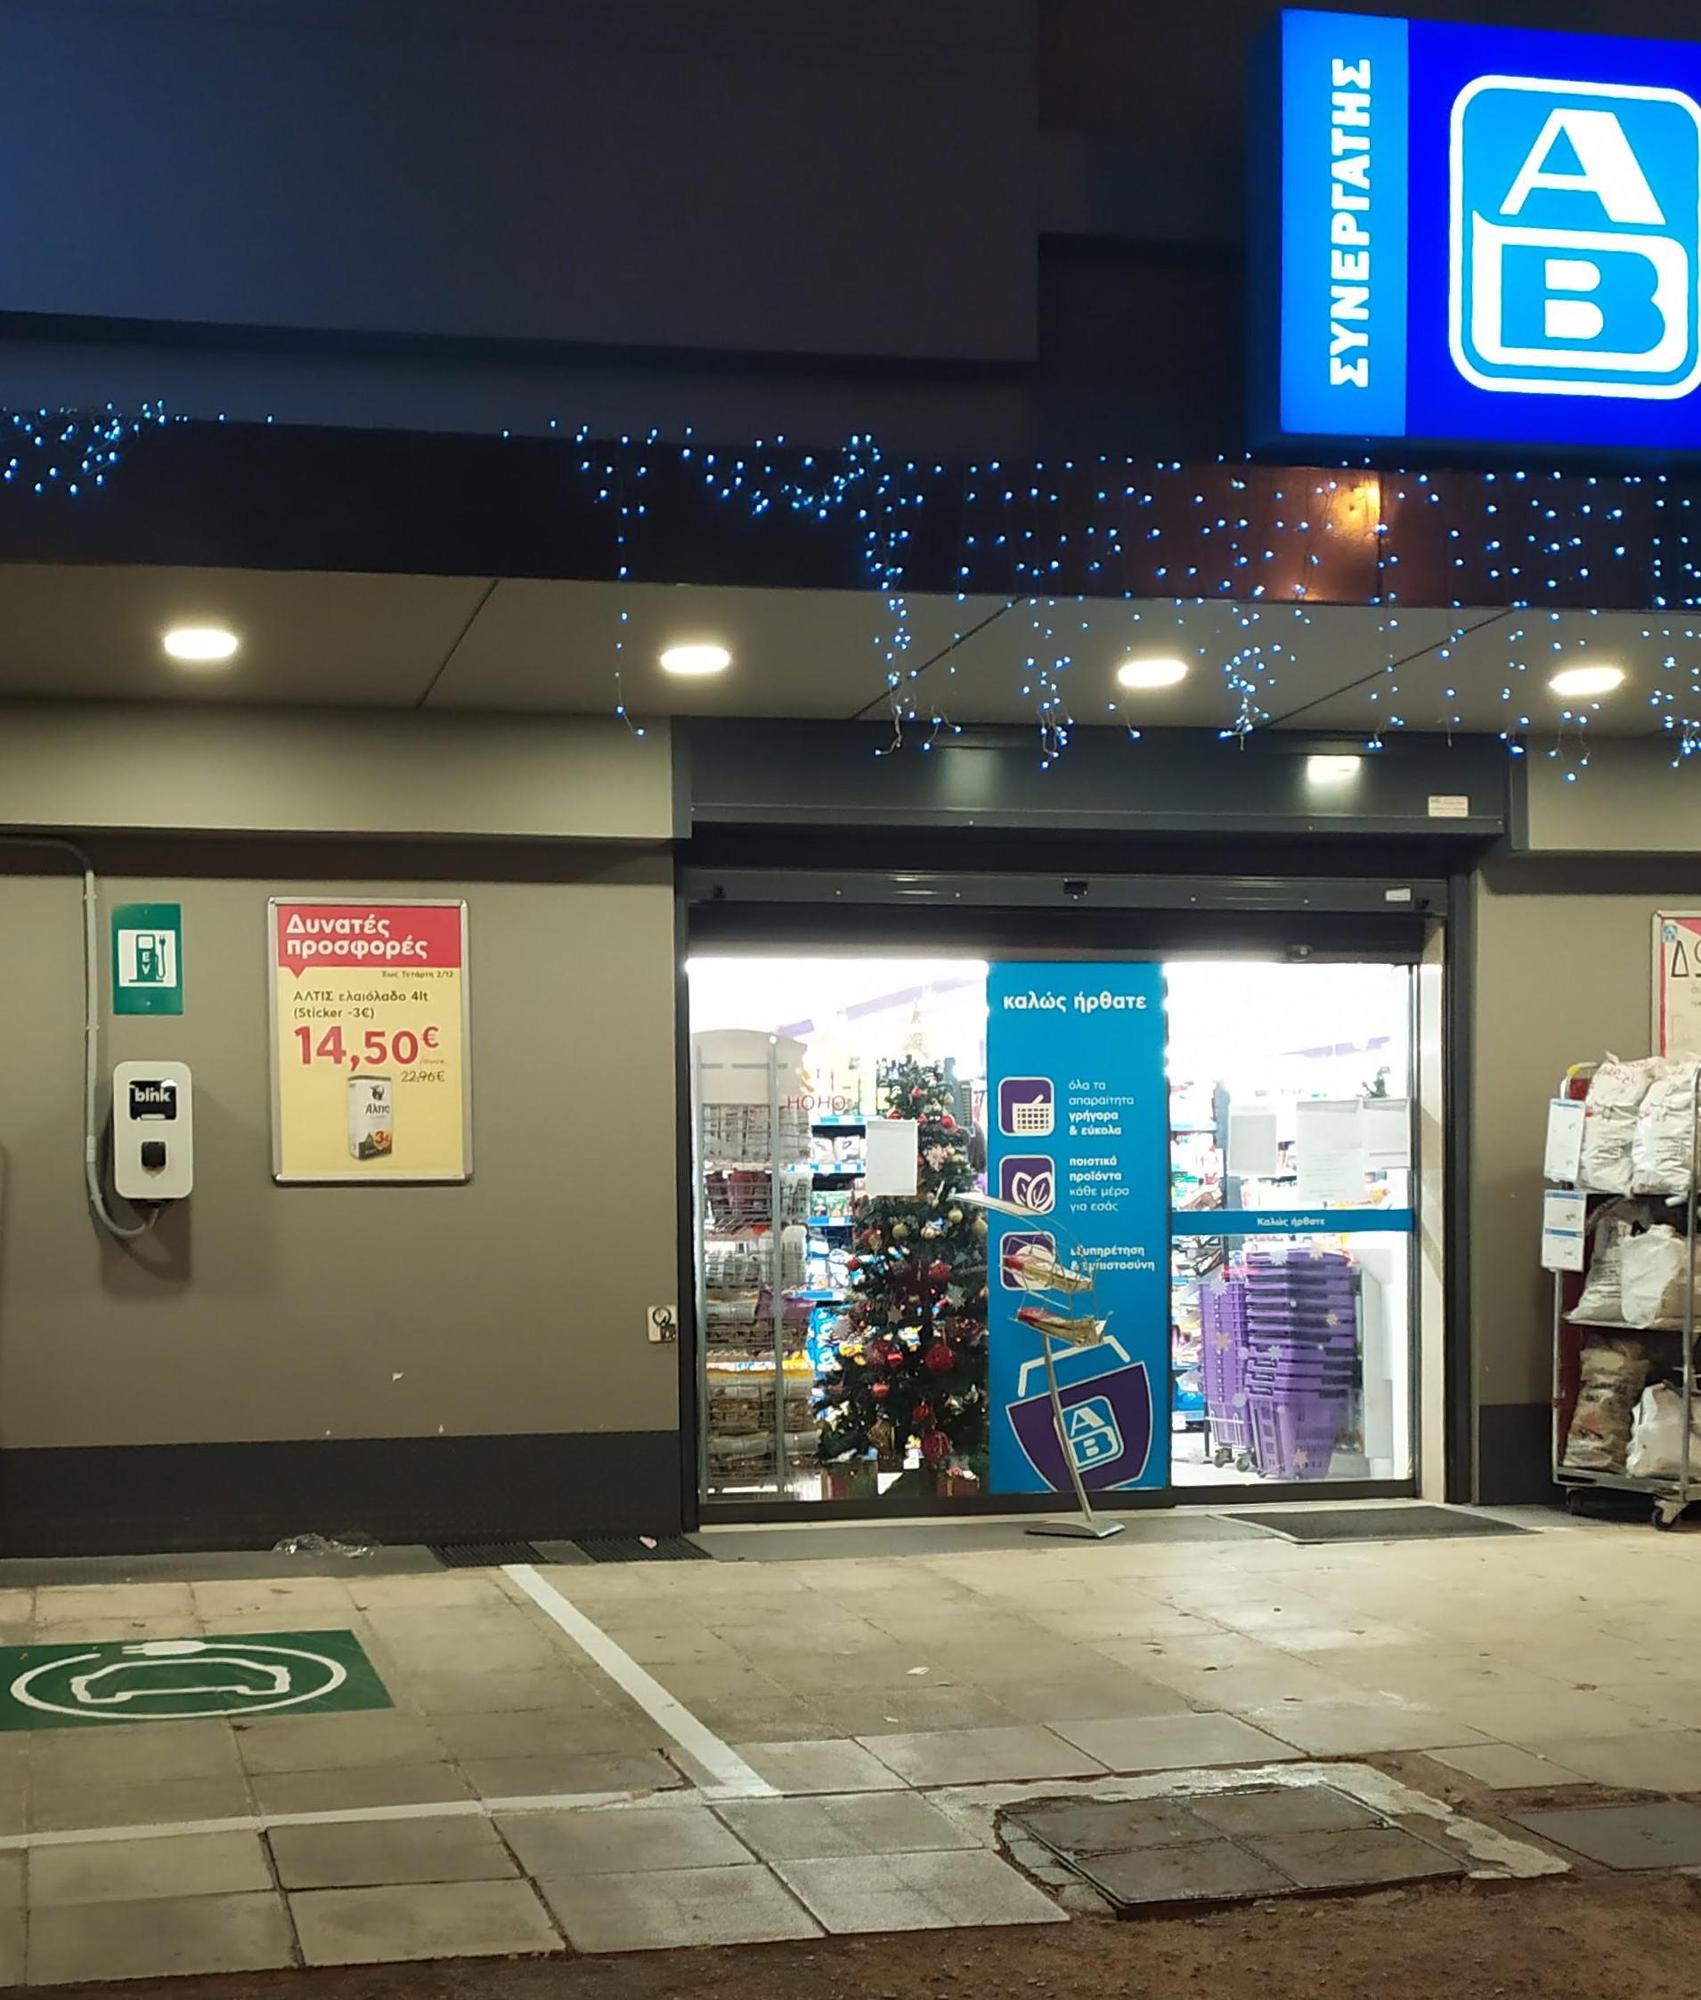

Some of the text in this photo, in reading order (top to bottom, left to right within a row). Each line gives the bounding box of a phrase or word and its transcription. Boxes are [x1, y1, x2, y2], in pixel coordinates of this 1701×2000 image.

[1330, 58, 1371, 388] ΣΥΝΕΡΓΑΤΗΣ
[286, 914, 390, 938] Δυνατές
[286, 935, 428, 960] προσφορές
[294, 990, 428, 1001] ΑΛΤΙΣ ελαιόλαδο 4lt
[1003, 990, 1147, 1013] καλώς ήρθατε
[293, 1007, 375, 1018] (Sticker -3€)
[1068, 1079, 1106, 1090] όλα τα
[134, 1087, 171, 1102] blink
[1068, 1095, 1134, 1106] απαραίτητα
[1068, 1110, 1119, 1123] γρήγορα
[1069, 1124, 1122, 1135] & εύκολα
[1069, 1185, 1098, 1197] κάθε
